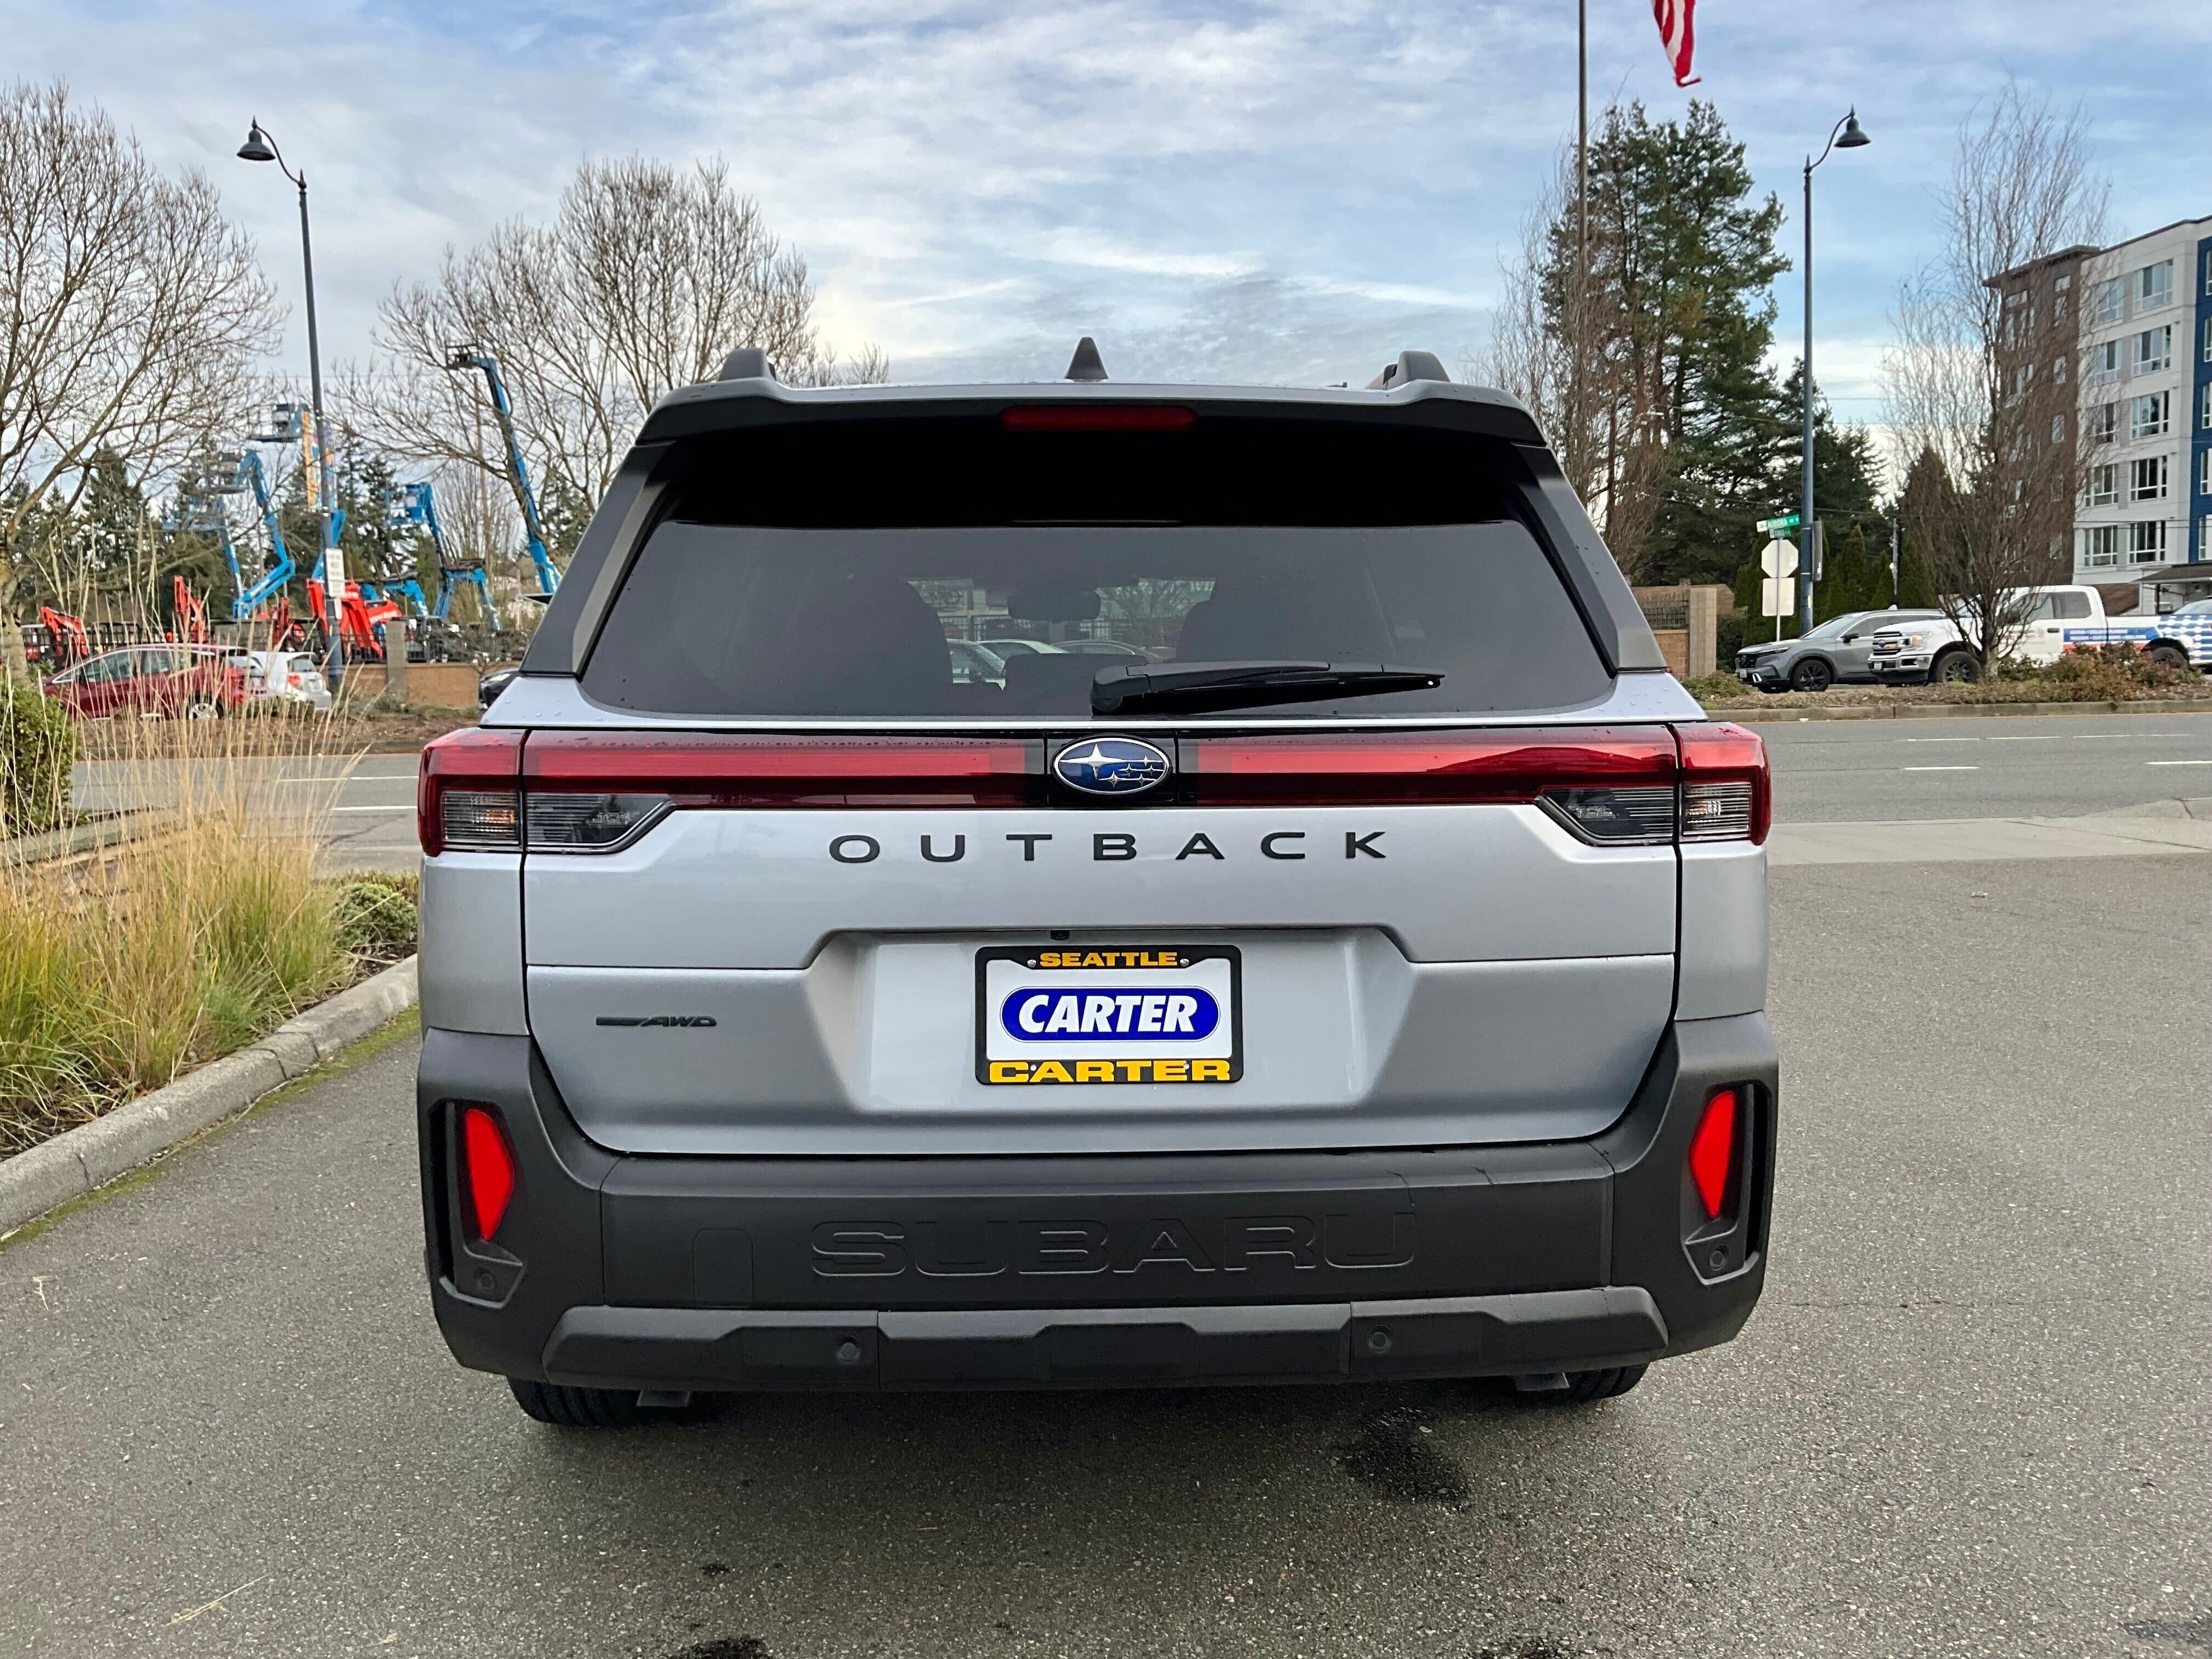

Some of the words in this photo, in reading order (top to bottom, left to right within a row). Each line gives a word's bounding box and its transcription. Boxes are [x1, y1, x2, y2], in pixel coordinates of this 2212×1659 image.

[828, 830, 1386, 862] OUTBACK
[1040, 952, 1178, 967] SEATTLE
[640, 1016, 716, 1027] AWD
[1019, 995, 1198, 1033] CARTER
[989, 1060, 1231, 1083] CARTER
[811, 1212, 1415, 1277] SUBARU
